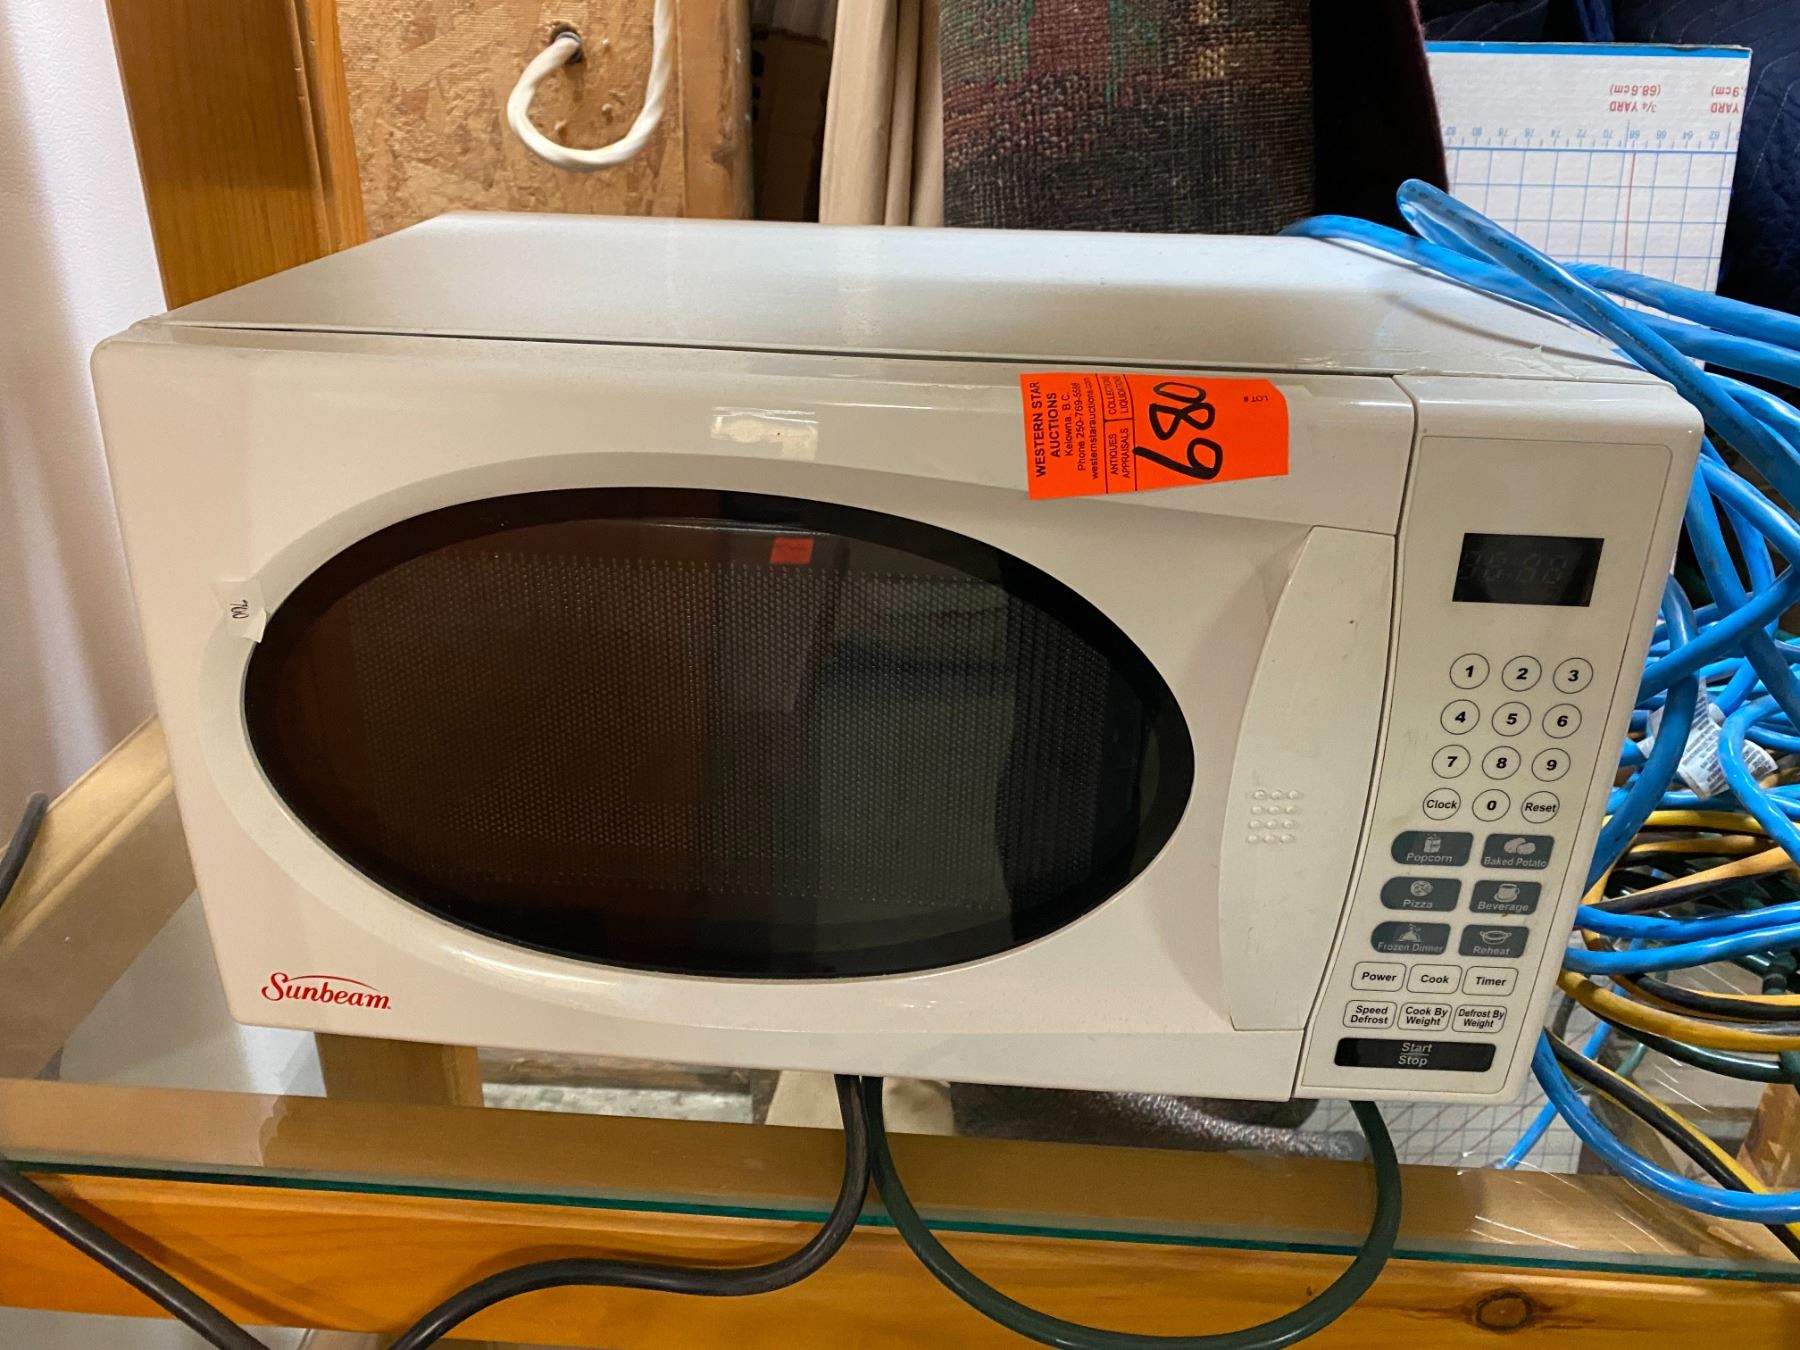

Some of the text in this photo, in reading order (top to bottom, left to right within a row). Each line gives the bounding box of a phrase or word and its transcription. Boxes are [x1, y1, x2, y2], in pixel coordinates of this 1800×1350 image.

[1711, 85, 1745, 97] .9cm)
[1609, 100, 1638, 112] YARD
[1710, 102, 1739, 113] YARD
[1602, 130, 1614, 138] 70
[1683, 130, 1694, 140] 64
[1251, 395, 1268, 403] LOT
[1030, 382, 1046, 478] WESTERN STAR
[1046, 392, 1060, 458] AUCTIONS
[1132, 382, 1223, 480] 680
[1075, 440, 1086, 471] Phone
[1108, 433, 1119, 476] ANTIQUES
[1120, 428, 1130, 478] APPRAISALS
[1465, 666, 1474, 678] 1
[1516, 668, 1528, 680] 2
[1568, 670, 1580, 682] 3
[1455, 712, 1466, 723] 4
[1506, 713, 1518, 725] 5
[1557, 715, 1568, 728] 6
[1448, 756, 1458, 768] 7
[1496, 758, 1508, 770] 8
[1546, 759, 1558, 771] 9
[1426, 798, 1458, 810] Clock
[1486, 800, 1497, 812] 0
[1524, 802, 1557, 813] Reset
[1406, 852, 1452, 864] Popcorn
[1484, 856, 1548, 868] Baked Potato
[1402, 899, 1433, 909] Pizza
[1477, 901, 1529, 913] Beverage
[1377, 941, 1444, 952] Frozen Dinner
[1472, 945, 1510, 956] Reheat
[1362, 972, 1398, 982] Power
[1420, 974, 1450, 985] Cook
[1476, 976, 1507, 987] Timer
[261, 972, 391, 1010] Sunbeam
[1355, 1005, 1388, 1017] Speed
[1405, 1006, 1448, 1018] Cook By
[1458, 1008, 1505, 1020] Defrost By
[1350, 1014, 1388, 1024] Defrost
[1406, 1016, 1441, 1027] Weight
[1463, 1018, 1494, 1029] Weight
[1401, 1042, 1432, 1053] Start
[1398, 1056, 1428, 1068] Stop
